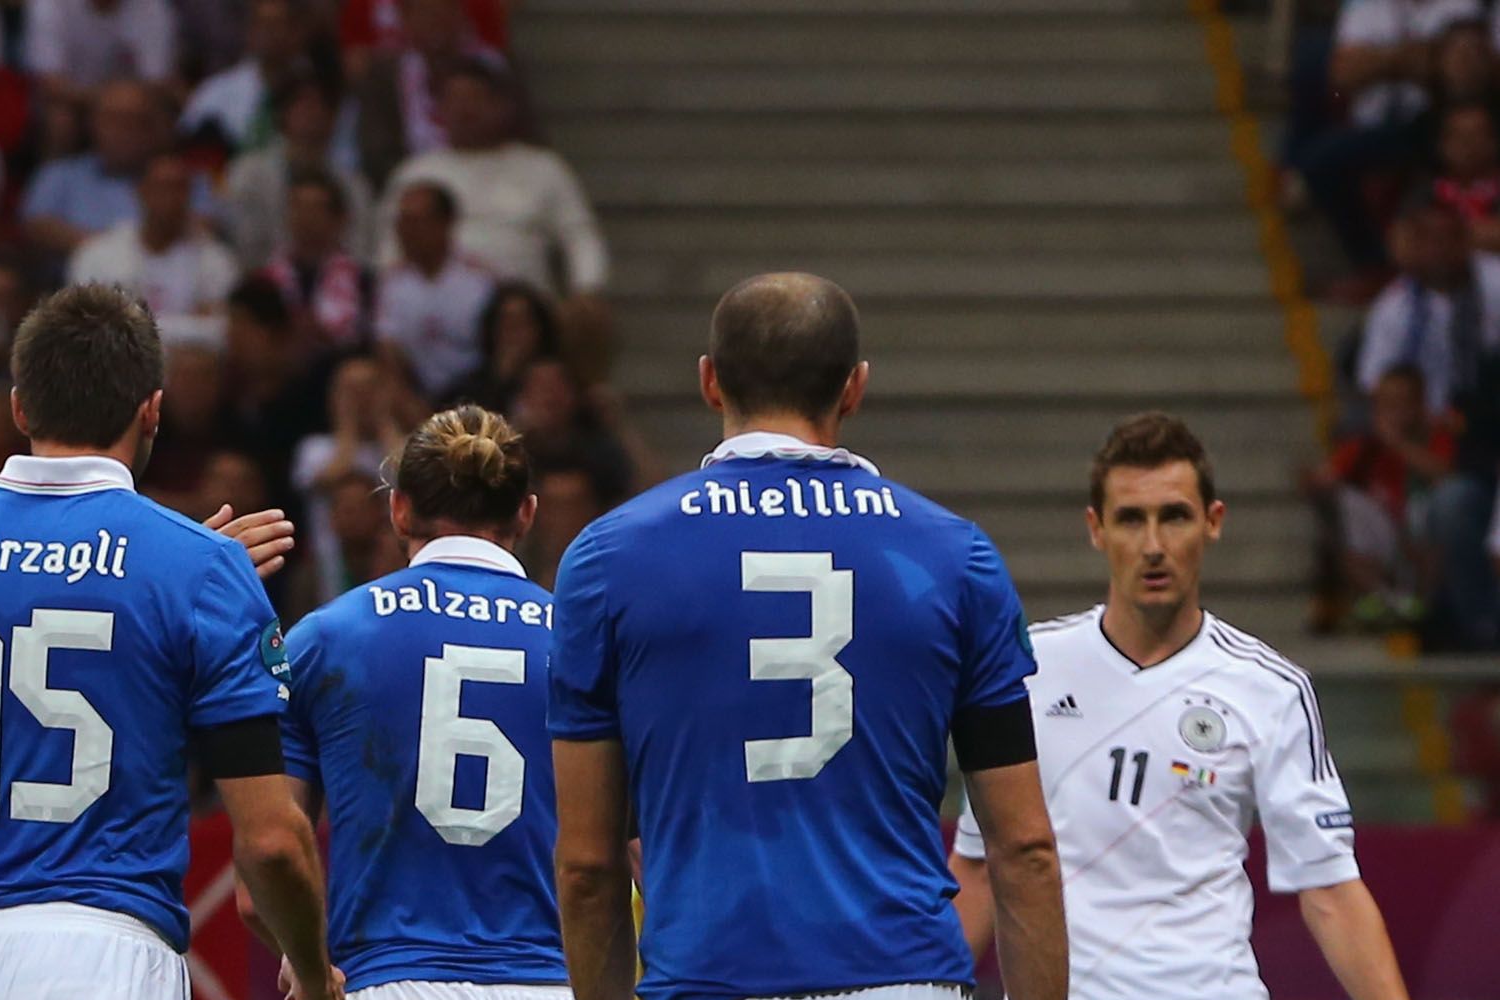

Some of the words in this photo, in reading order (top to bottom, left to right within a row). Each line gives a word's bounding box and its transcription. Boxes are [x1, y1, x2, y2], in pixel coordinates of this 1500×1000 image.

[679, 477, 902, 519] chiellini
[740, 550, 854, 784] 3
[414, 642, 527, 848] 6
[1108, 746, 1150, 807] 11
